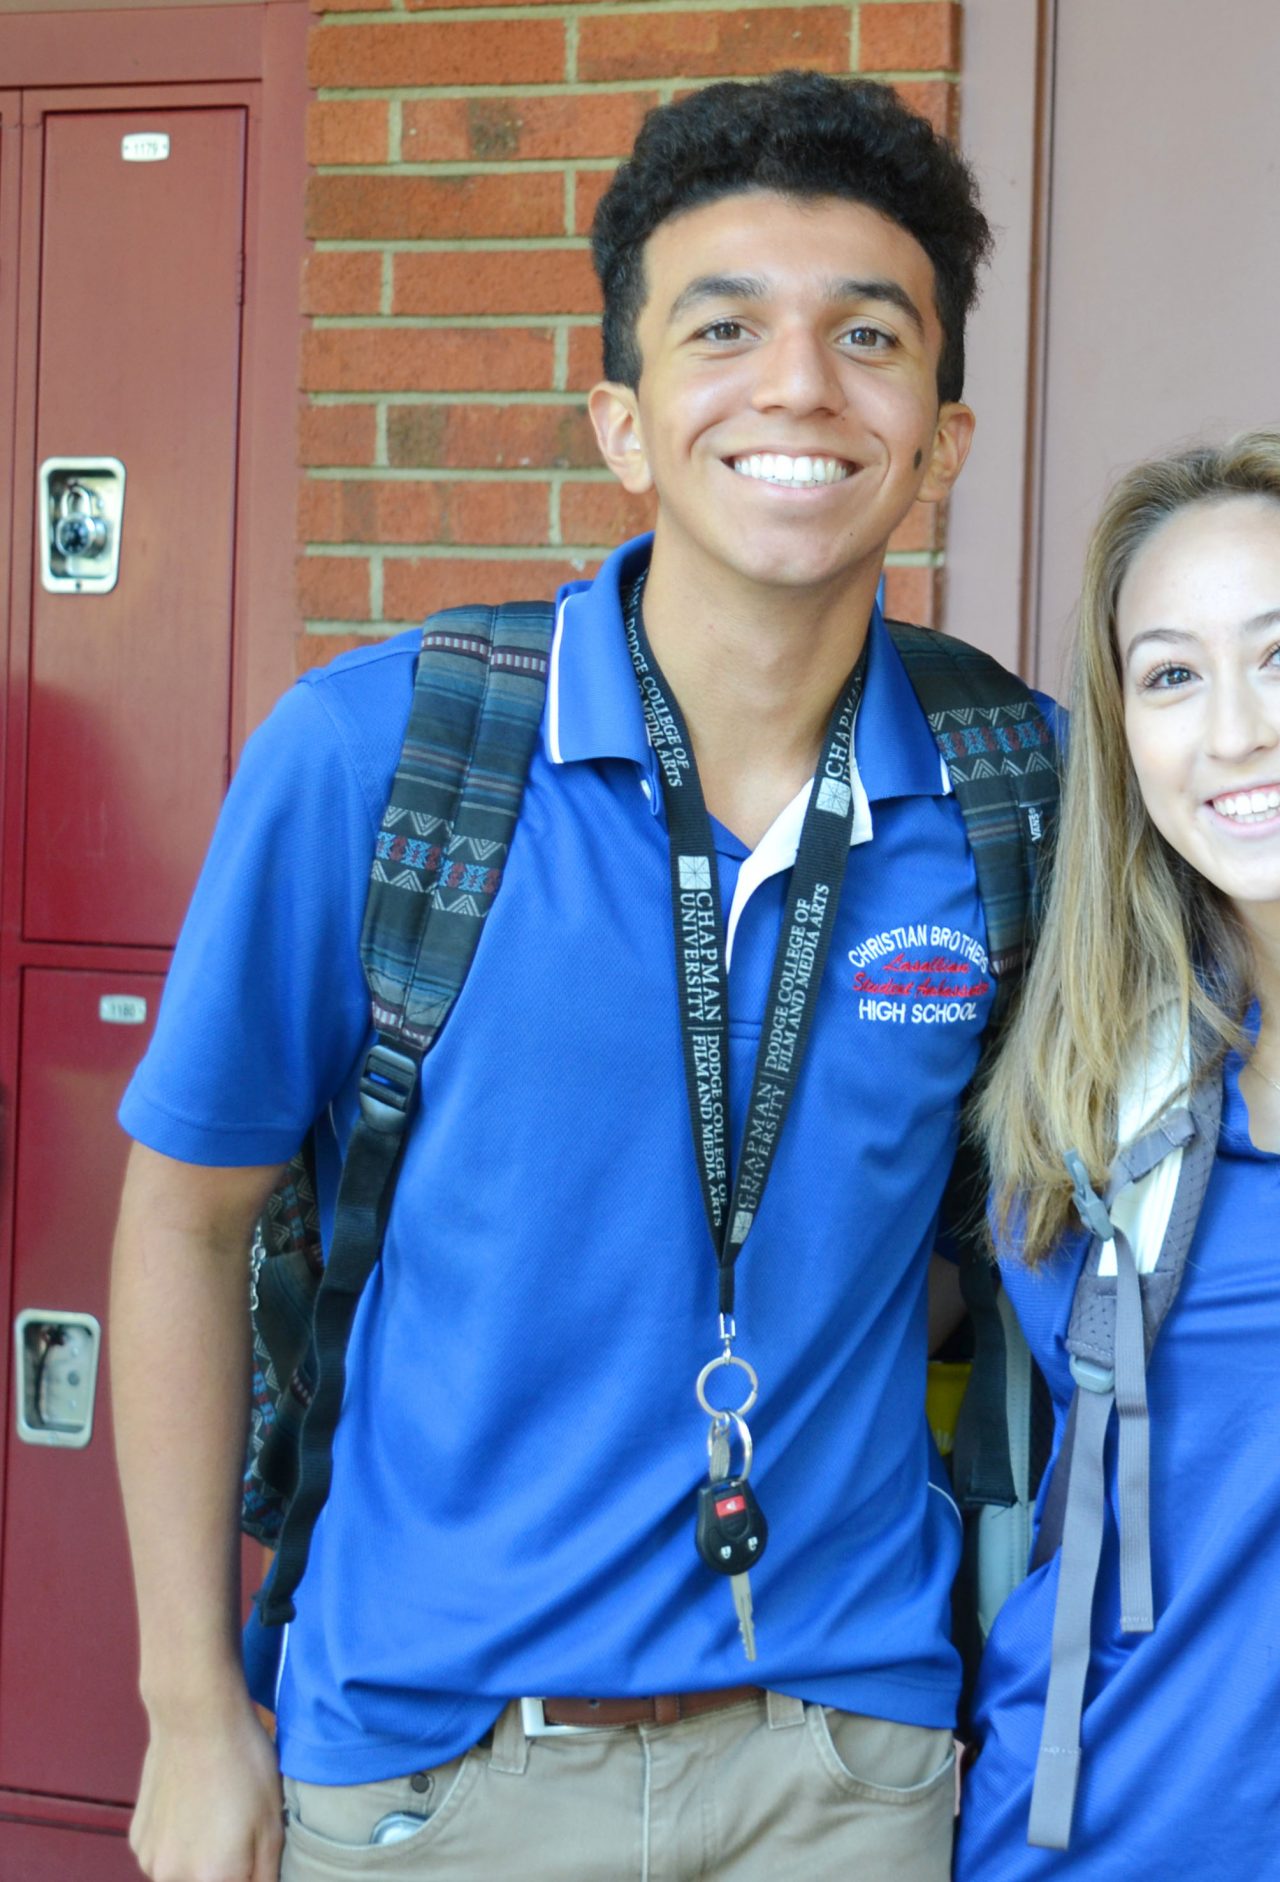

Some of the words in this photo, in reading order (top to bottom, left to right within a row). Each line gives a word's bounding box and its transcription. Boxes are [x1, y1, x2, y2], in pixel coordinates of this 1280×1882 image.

[625, 617, 649, 676] DODGE
[642, 676, 682, 745] COLLEGE
[673, 747, 691, 769] OF
[657, 749, 683, 787] ARTS
[1028, 813, 1042, 842] VANS
[680, 892, 705, 1021] UNIVERSITY
[696, 891, 721, 1021] CHAPMAN
[848, 924, 928, 968] CHRISTIAN
[765, 1005, 789, 1069] DODGE
[778, 924, 806, 1003] COLLEGE
[794, 898, 812, 923] OF
[777, 1031, 798, 1073] FILM
[788, 990, 807, 1030] AND
[798, 931, 820, 989] MEDIA
[810, 882, 830, 928] ARTS
[858, 998, 907, 1024] HIGH
[911, 1002, 977, 1024] SCHOOL
[692, 1035, 709, 1077] FILM
[707, 1034, 723, 1098] DODGE
[697, 1080, 713, 1120] AND
[702, 1124, 716, 1181] MEDIA
[711, 1102, 727, 1179] COLLEGE
[737, 1082, 772, 1209] CHAPMAN
[748, 1084, 785, 1209] UNIVERSITY
[708, 1183, 723, 1227] ARTS
[717, 1183, 728, 1207] OF
